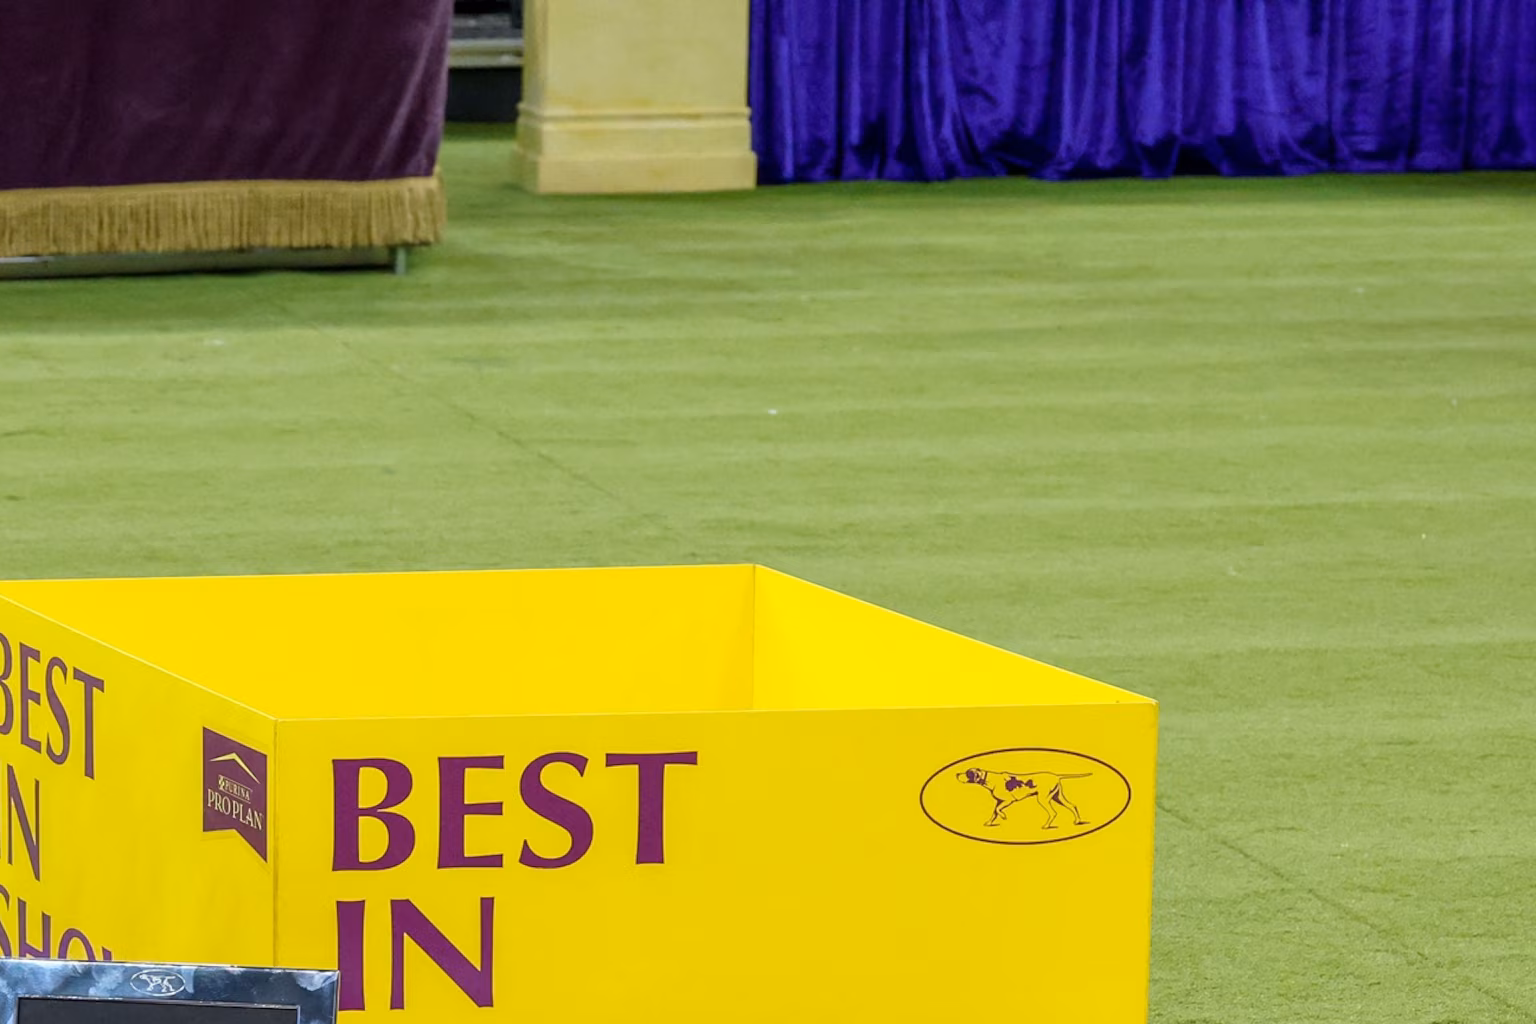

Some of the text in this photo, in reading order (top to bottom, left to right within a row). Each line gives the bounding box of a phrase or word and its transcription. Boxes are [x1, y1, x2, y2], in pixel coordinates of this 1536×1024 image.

[207, 788, 263, 831] PRO PLAN
[224, 780, 251, 801] PURINA
[331, 750, 698, 872] BEST
[336, 896, 495, 1012] IN
